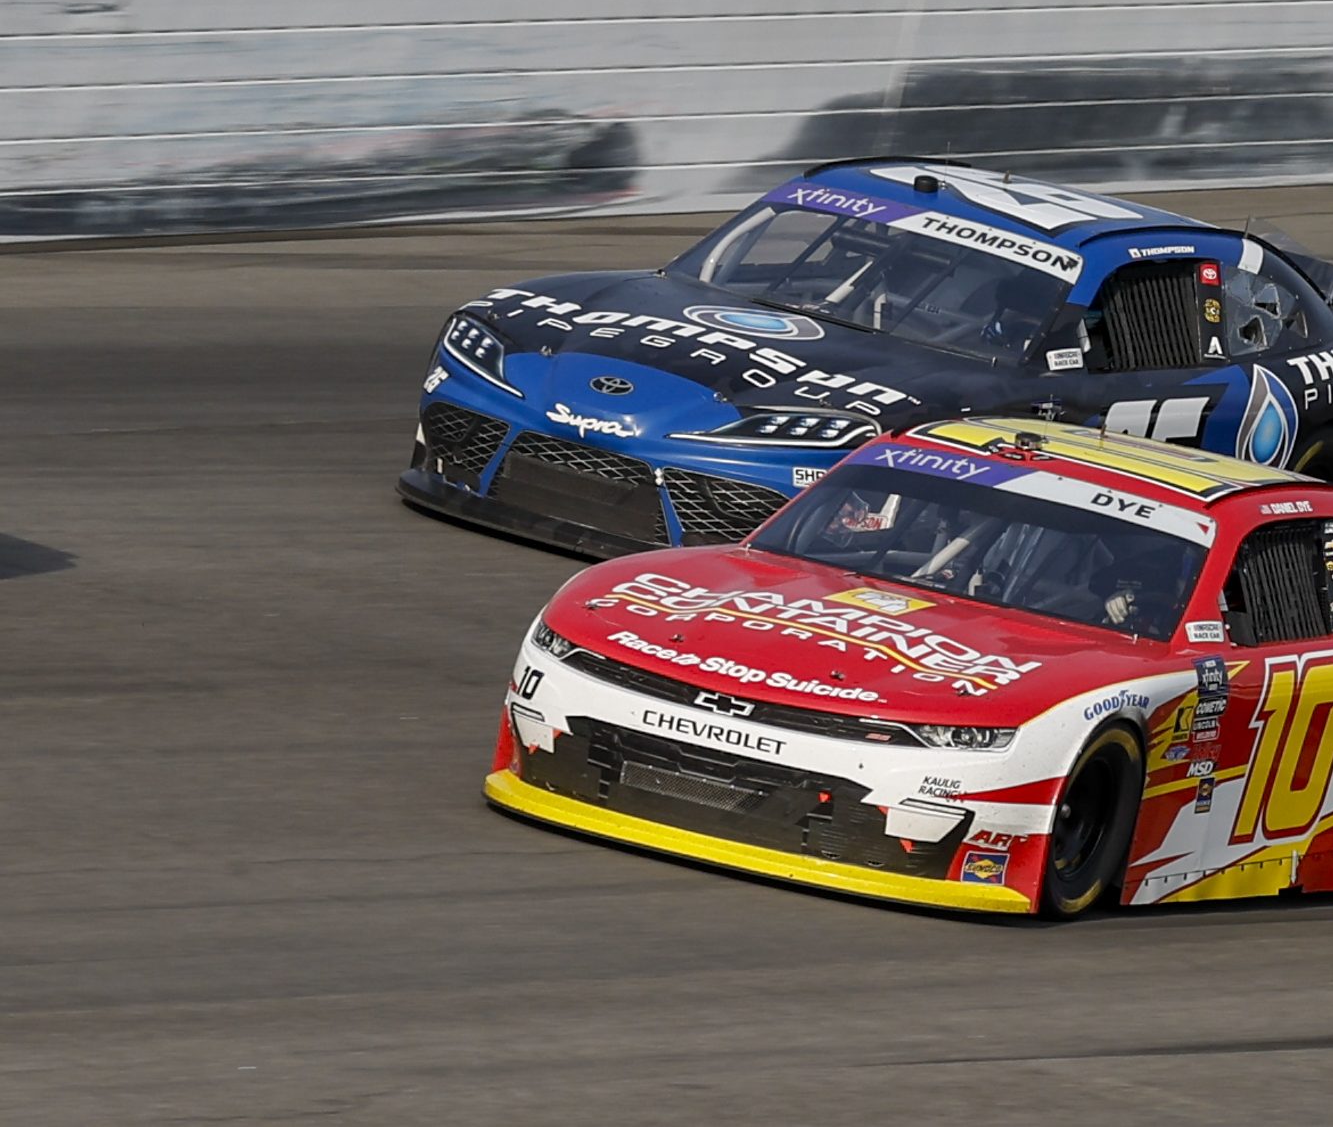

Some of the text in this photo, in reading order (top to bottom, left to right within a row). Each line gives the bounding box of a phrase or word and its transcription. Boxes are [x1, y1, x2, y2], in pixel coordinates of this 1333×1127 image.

[787, 185, 887, 219] xfinity
[923, 217, 1074, 272] THOMPSON
[545, 402, 636, 439] Supra
[875, 447, 991, 480] xfinity
[1090, 492, 1157, 520] DYE
[612, 582, 1021, 688] CONTAINER
[634, 572, 1042, 674] CHAMPION
[607, 630, 676, 666] Race
[697, 656, 767, 687] Stop
[518, 665, 545, 700] 10
[642, 710, 787, 756] CHEVROLET
[922, 776, 962, 790] KAULIG
[1187, 762, 1214, 778] MSD
